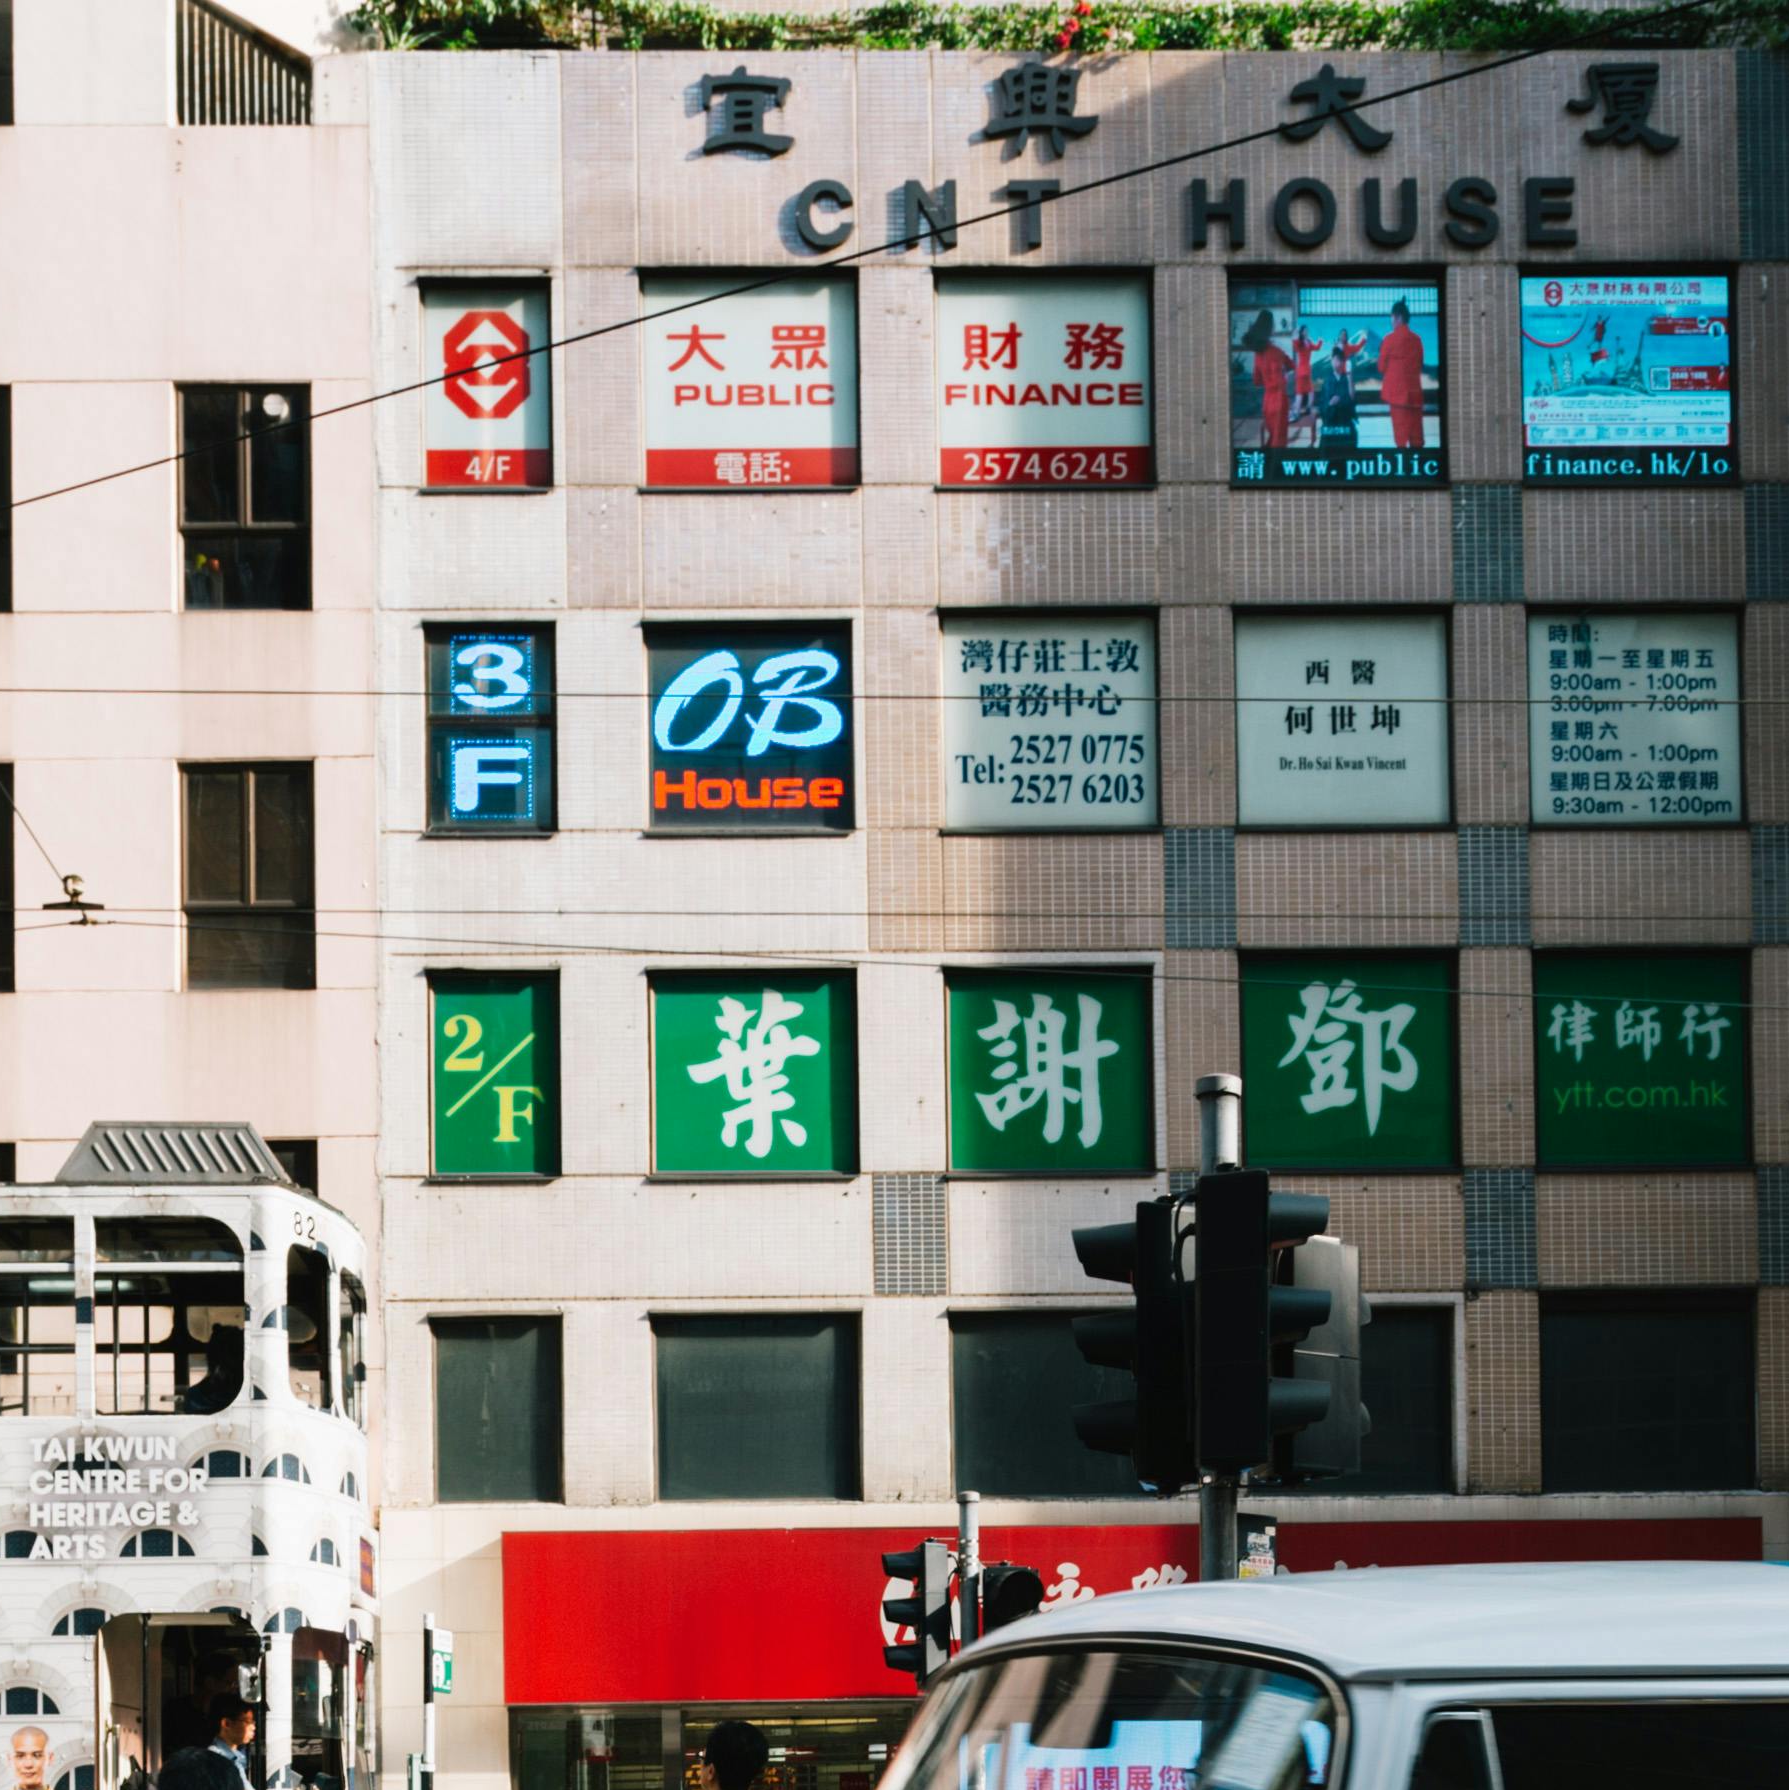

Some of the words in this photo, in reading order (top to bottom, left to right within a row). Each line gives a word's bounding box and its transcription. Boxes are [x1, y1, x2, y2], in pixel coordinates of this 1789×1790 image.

[796, 179, 1061, 250] CNT
[1190, 177, 1580, 249] HOUSE
[667, 323, 828, 371] 大眾
[963, 322, 1125, 371] 財務
[674, 384, 835, 406] PUBLIC
[945, 383, 1143, 406] FINANCE
[464, 456, 511, 482] 4/F
[714, 451, 790, 484] 電話:
[963, 452, 1042, 481] 2574
[1051, 452, 1128, 480] 6245
[1237, 451, 1265, 479] 請
[1282, 454, 1439, 479] www.public
[1526, 451, 1730, 477] finance.hk/lo
[1548, 624, 1599, 643] 時間:
[960, 639, 1139, 675] 灣仔莊士敦
[1549, 649, 1713, 669] 星期一至星期五
[456, 645, 530, 708] 3
[1306, 659, 1375, 685] 西醫
[1550, 673, 1621, 690] 9:00am
[1647, 673, 1716, 692] 1:00pm
[654, 650, 843, 756] OB
[979, 683, 1123, 718] 醫務中心
[1285, 704, 1400, 735] 何世坤
[1550, 721, 1618, 741] 星期六
[955, 755, 1006, 787] Tel:
[1010, 735, 1075, 767] 2527
[1081, 734, 1145, 766] 0775
[1279, 757, 1297, 770] Dr.
[1299, 757, 1313, 770] Ho
[1316, 757, 1332, 770] Sai
[1335, 757, 1363, 770] Kwan
[1367, 757, 1406, 770] Vincent
[1552, 745, 1622, 762] 9:00am
[1648, 745, 1718, 764] 1:00pm
[456, 747, 529, 811] F
[654, 771, 843, 809] House
[1010, 773, 1075, 805] 2527
[1081, 773, 1145, 804] 6203
[1550, 771, 1719, 791] 星期日及公眾假期
[1553, 797, 1623, 814] 9:30am
[1649, 797, 1732, 815] 12:00pm
[443, 1014, 543, 1144] 2/F
[687, 989, 821, 1159] 葉
[975, 994, 1120, 1148] 謝
[1278, 979, 1419, 1136] 鄧
[1547, 1001, 1732, 1062] 律師行
[1551, 1079, 1728, 1115] ytt.com.hk
[293, 1211, 317, 1241] 82
[30, 1438, 77, 1463] TAI
[83, 1437, 176, 1462] KWUN
[29, 1470, 143, 1495] CENTRE
[149, 1468, 208, 1494] FOR
[29, 1501, 174, 1528] HERITAGE
[178, 1501, 199, 1527] &
[29, 1534, 106, 1560] ARTS
